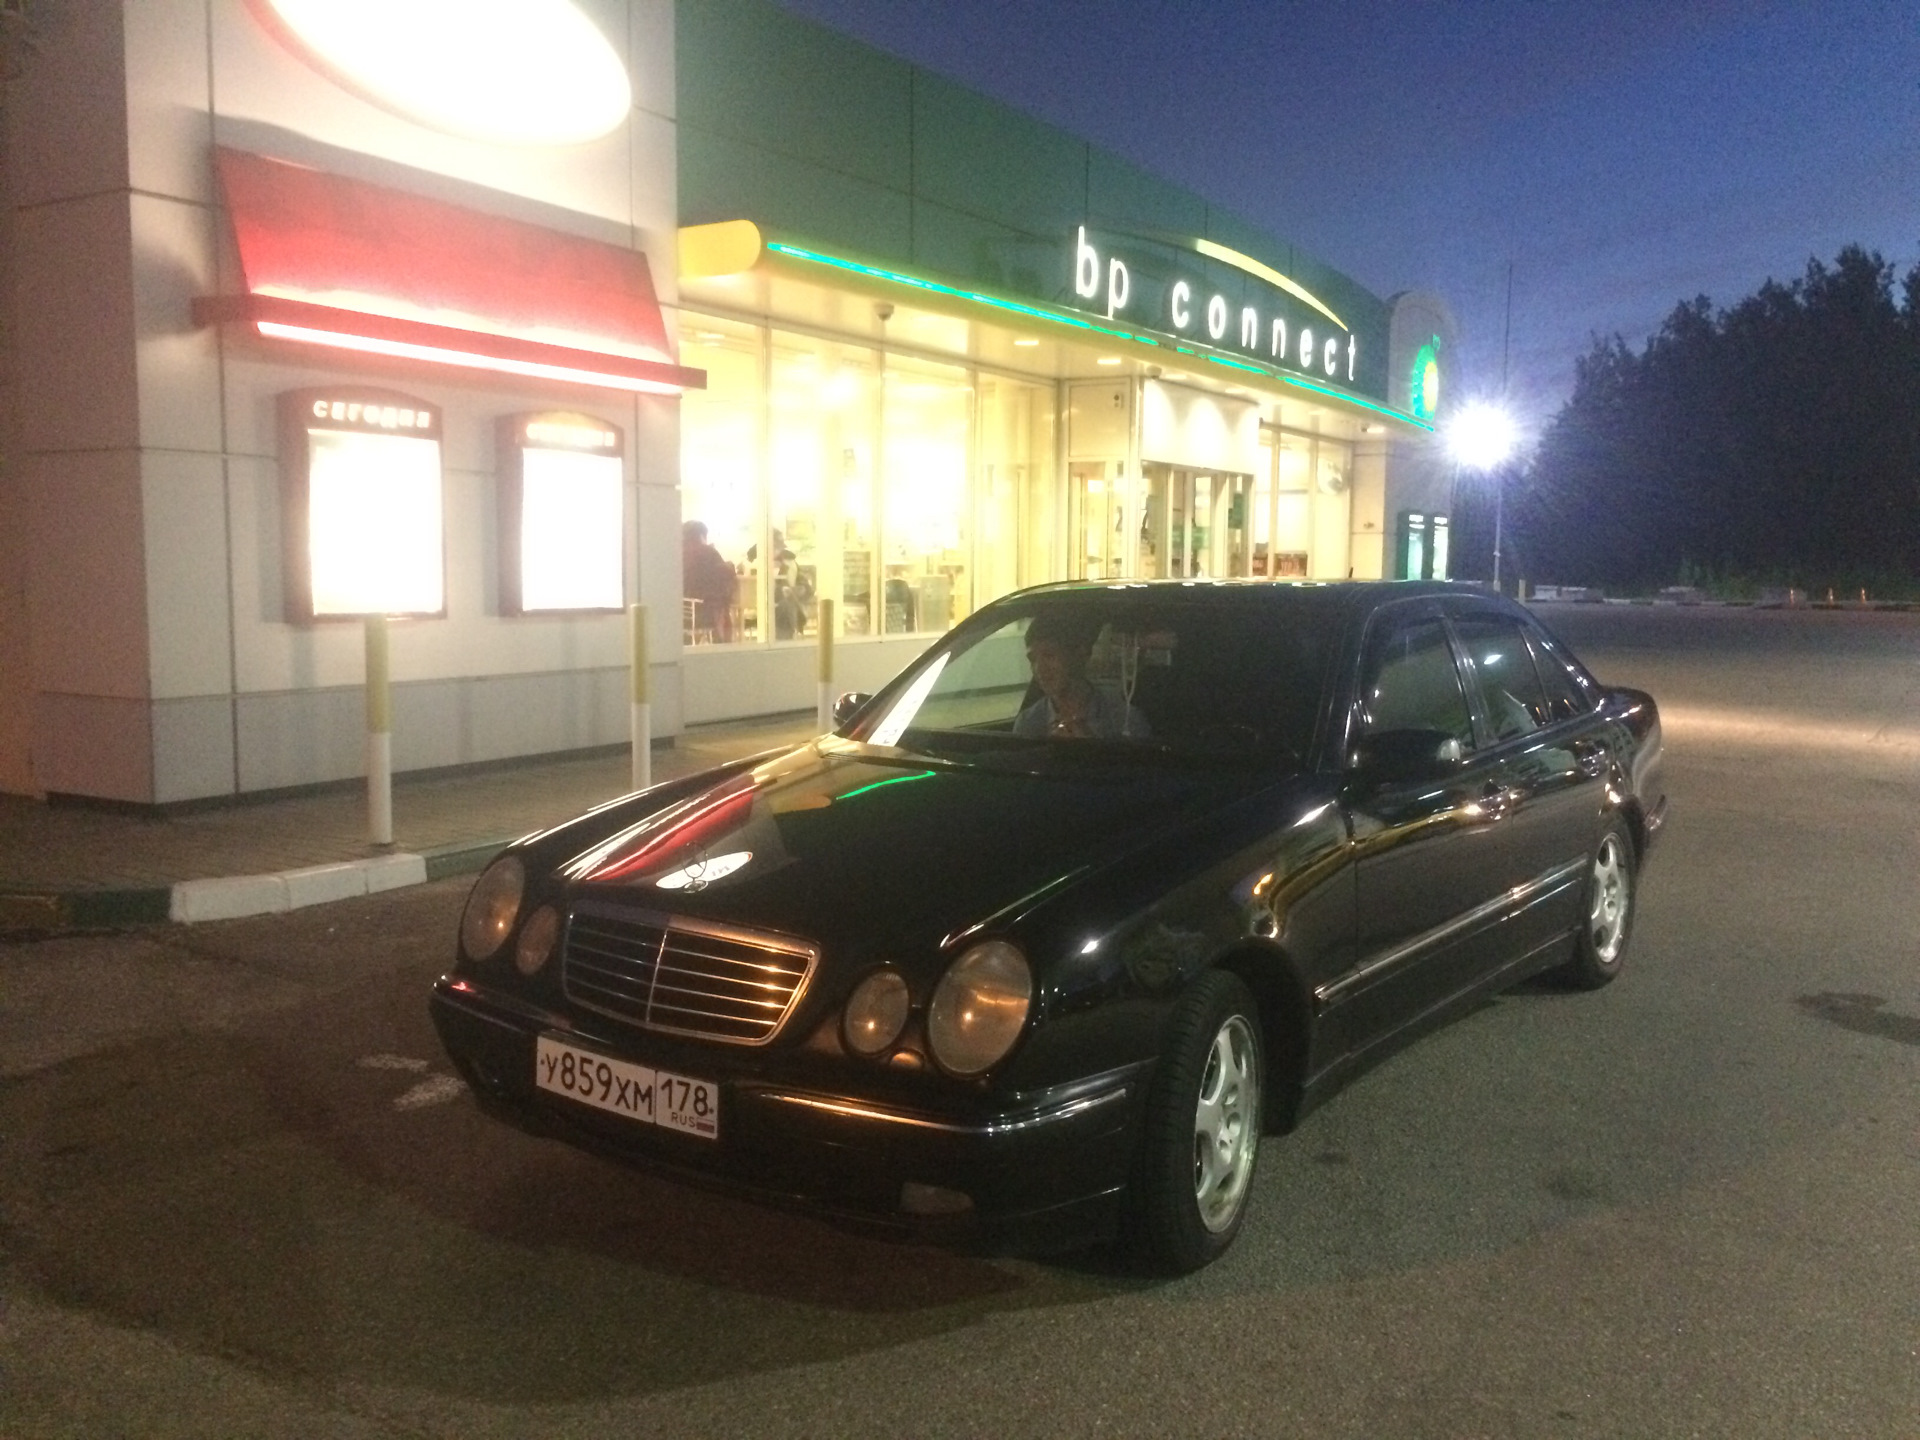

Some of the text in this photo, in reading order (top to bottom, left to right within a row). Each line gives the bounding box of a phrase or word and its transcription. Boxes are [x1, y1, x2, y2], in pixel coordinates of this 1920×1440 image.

[1075, 225, 1356, 382] bp connect
[660, 1078, 708, 1117] 178
[671, 1111, 696, 1128] RUS
